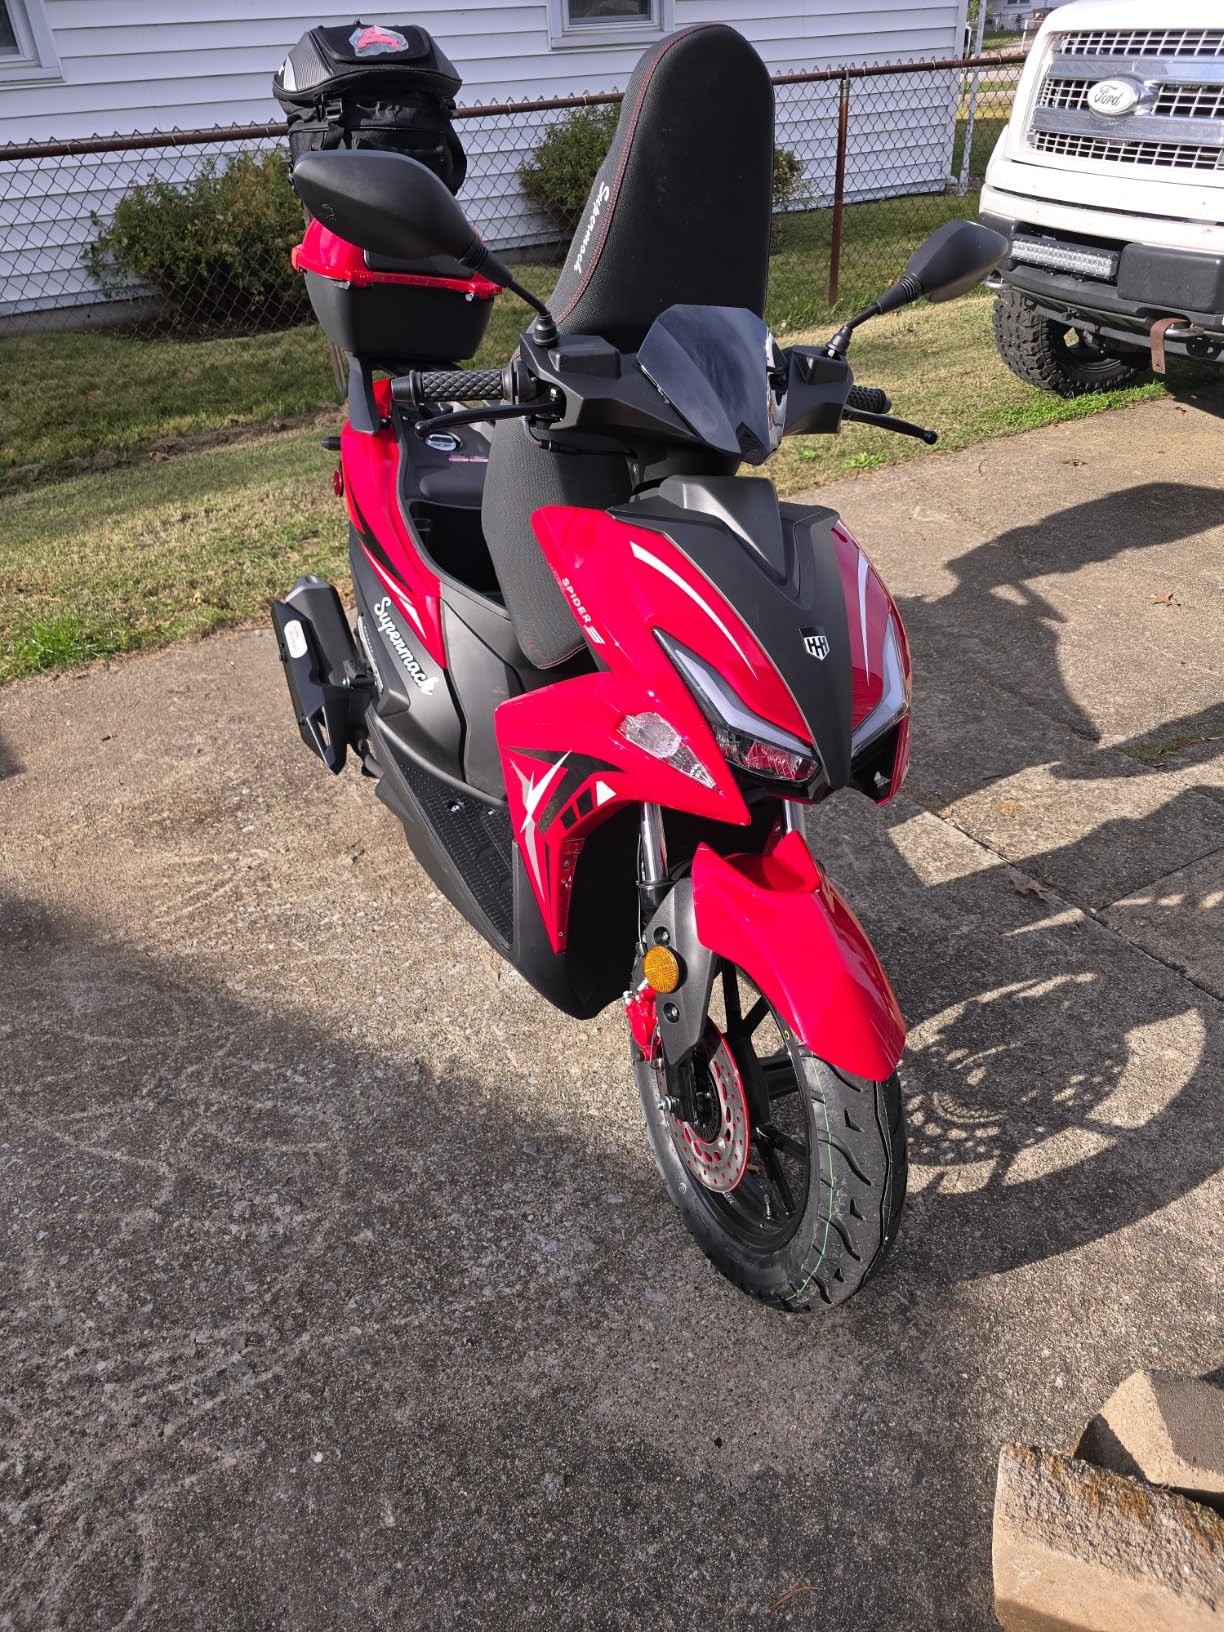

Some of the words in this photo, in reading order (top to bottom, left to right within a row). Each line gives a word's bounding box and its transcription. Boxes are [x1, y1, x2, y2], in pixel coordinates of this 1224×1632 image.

[1094, 85, 1124, 106] Ford
[562, 577, 592, 624] SPIDER
[374, 596, 439, 696] Supermach
